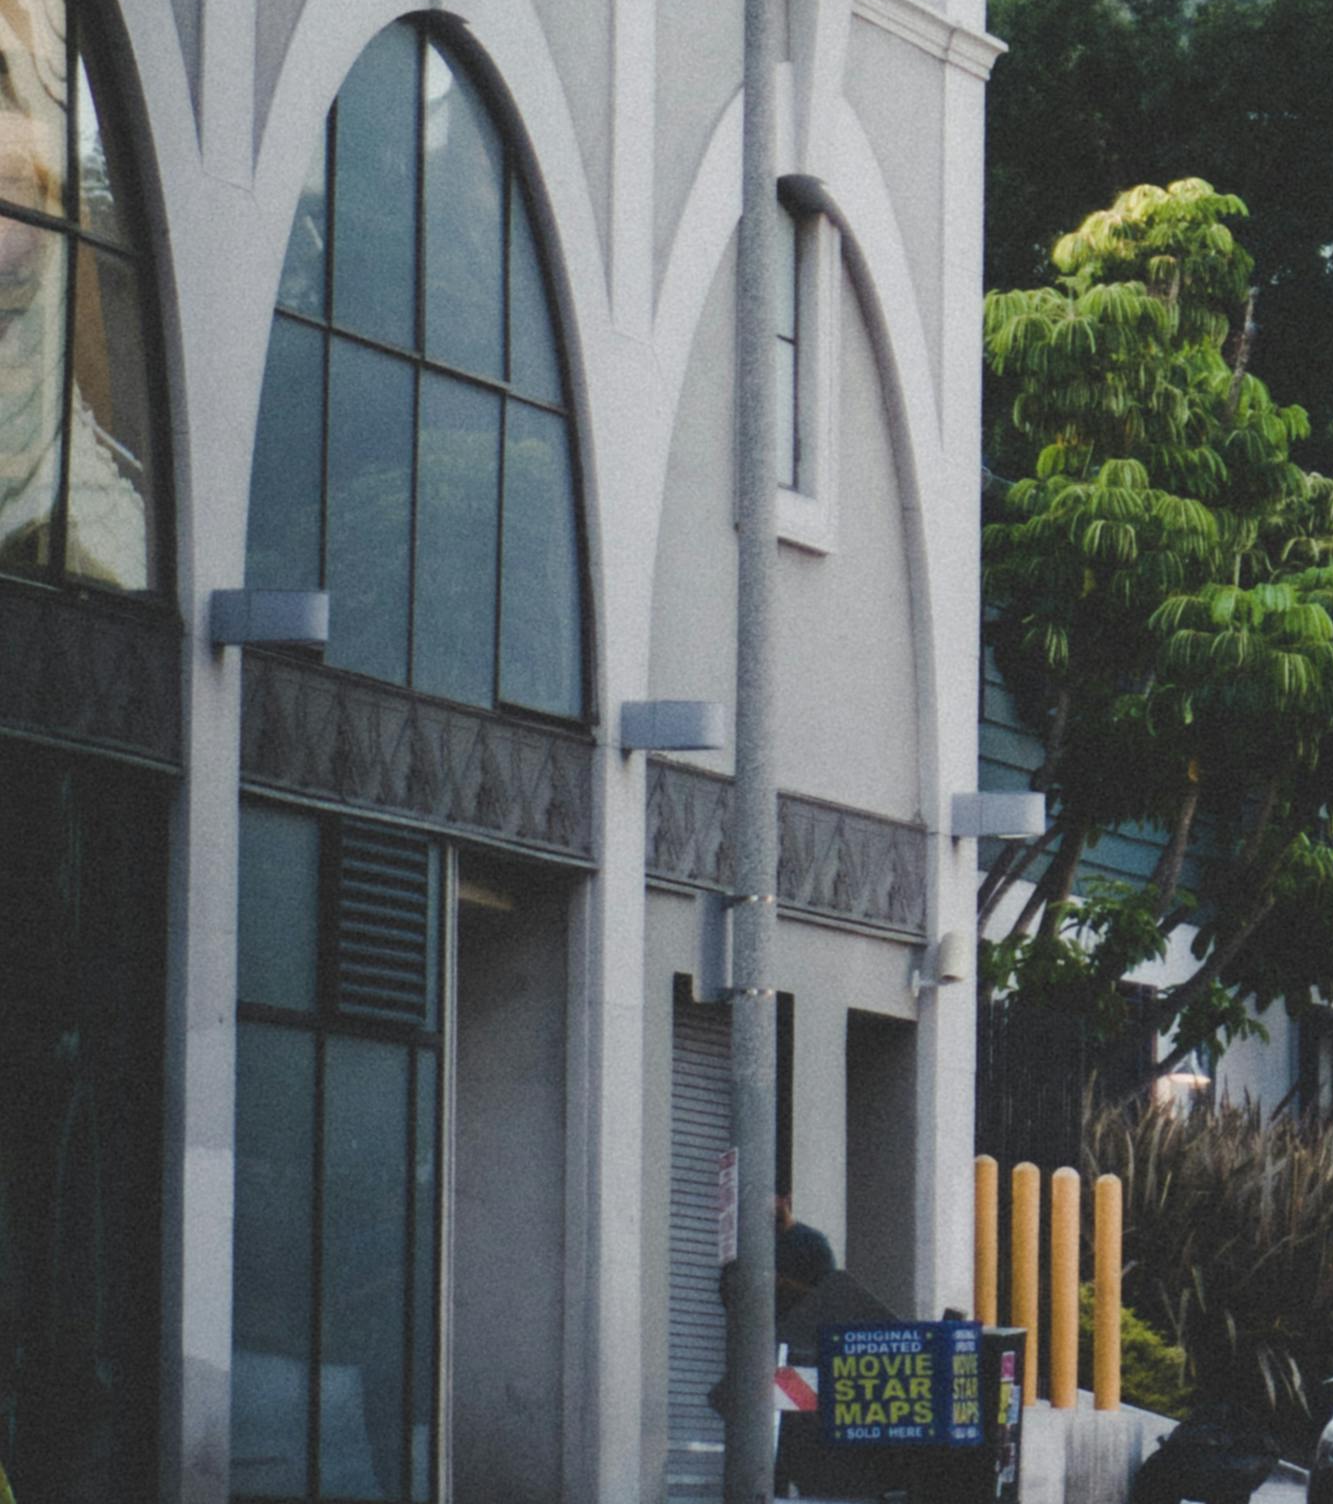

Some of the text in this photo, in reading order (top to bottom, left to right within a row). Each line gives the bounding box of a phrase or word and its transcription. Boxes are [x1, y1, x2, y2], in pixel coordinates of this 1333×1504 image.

[844, 1330, 921, 1342] ORIGINAL
[844, 1342, 922, 1354] UPDATED
[832, 1354, 934, 1377] MOVIE
[834, 1377, 934, 1401] STAR
[834, 1401, 934, 1425] MAPS
[846, 1426, 923, 1439] SOLD HERE
